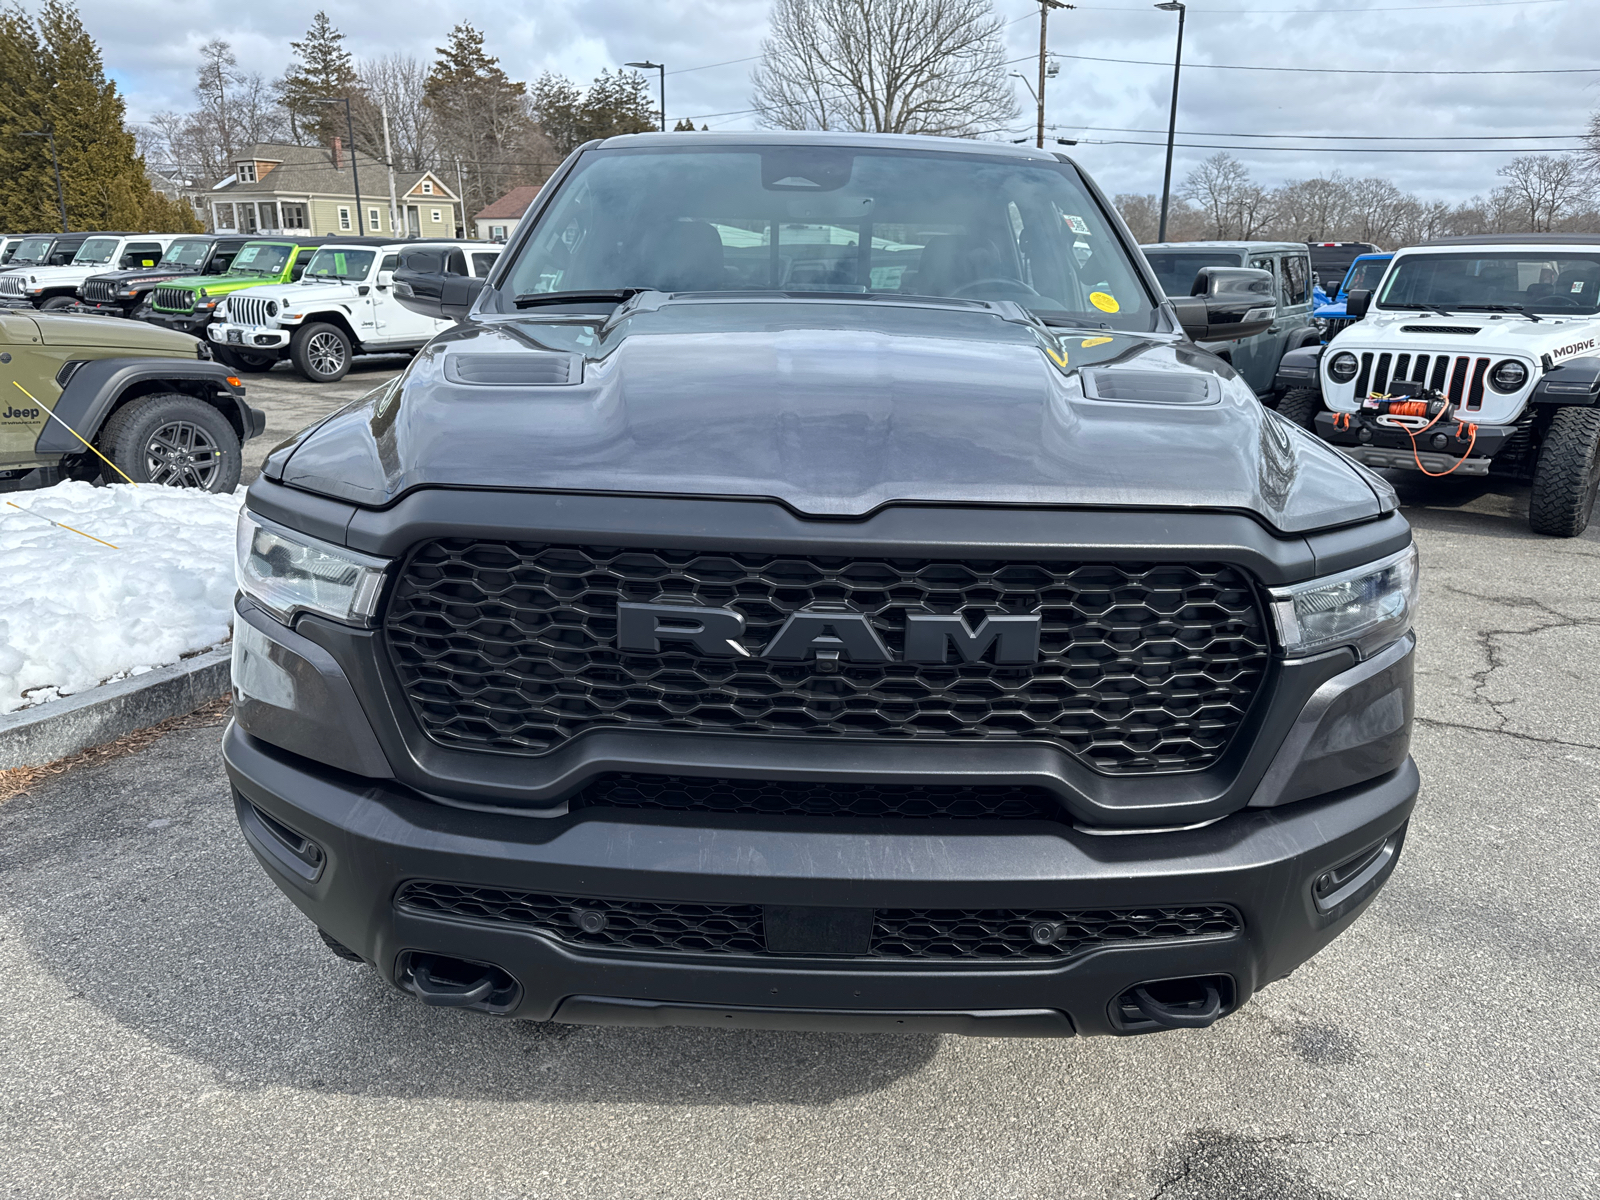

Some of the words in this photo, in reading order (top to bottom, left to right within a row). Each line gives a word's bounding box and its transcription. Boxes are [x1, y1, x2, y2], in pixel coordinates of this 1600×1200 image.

[1553, 338, 1595, 358] MOJAVE
[2, 406, 40, 420] Jeep
[616, 600, 1042, 664] RAM
